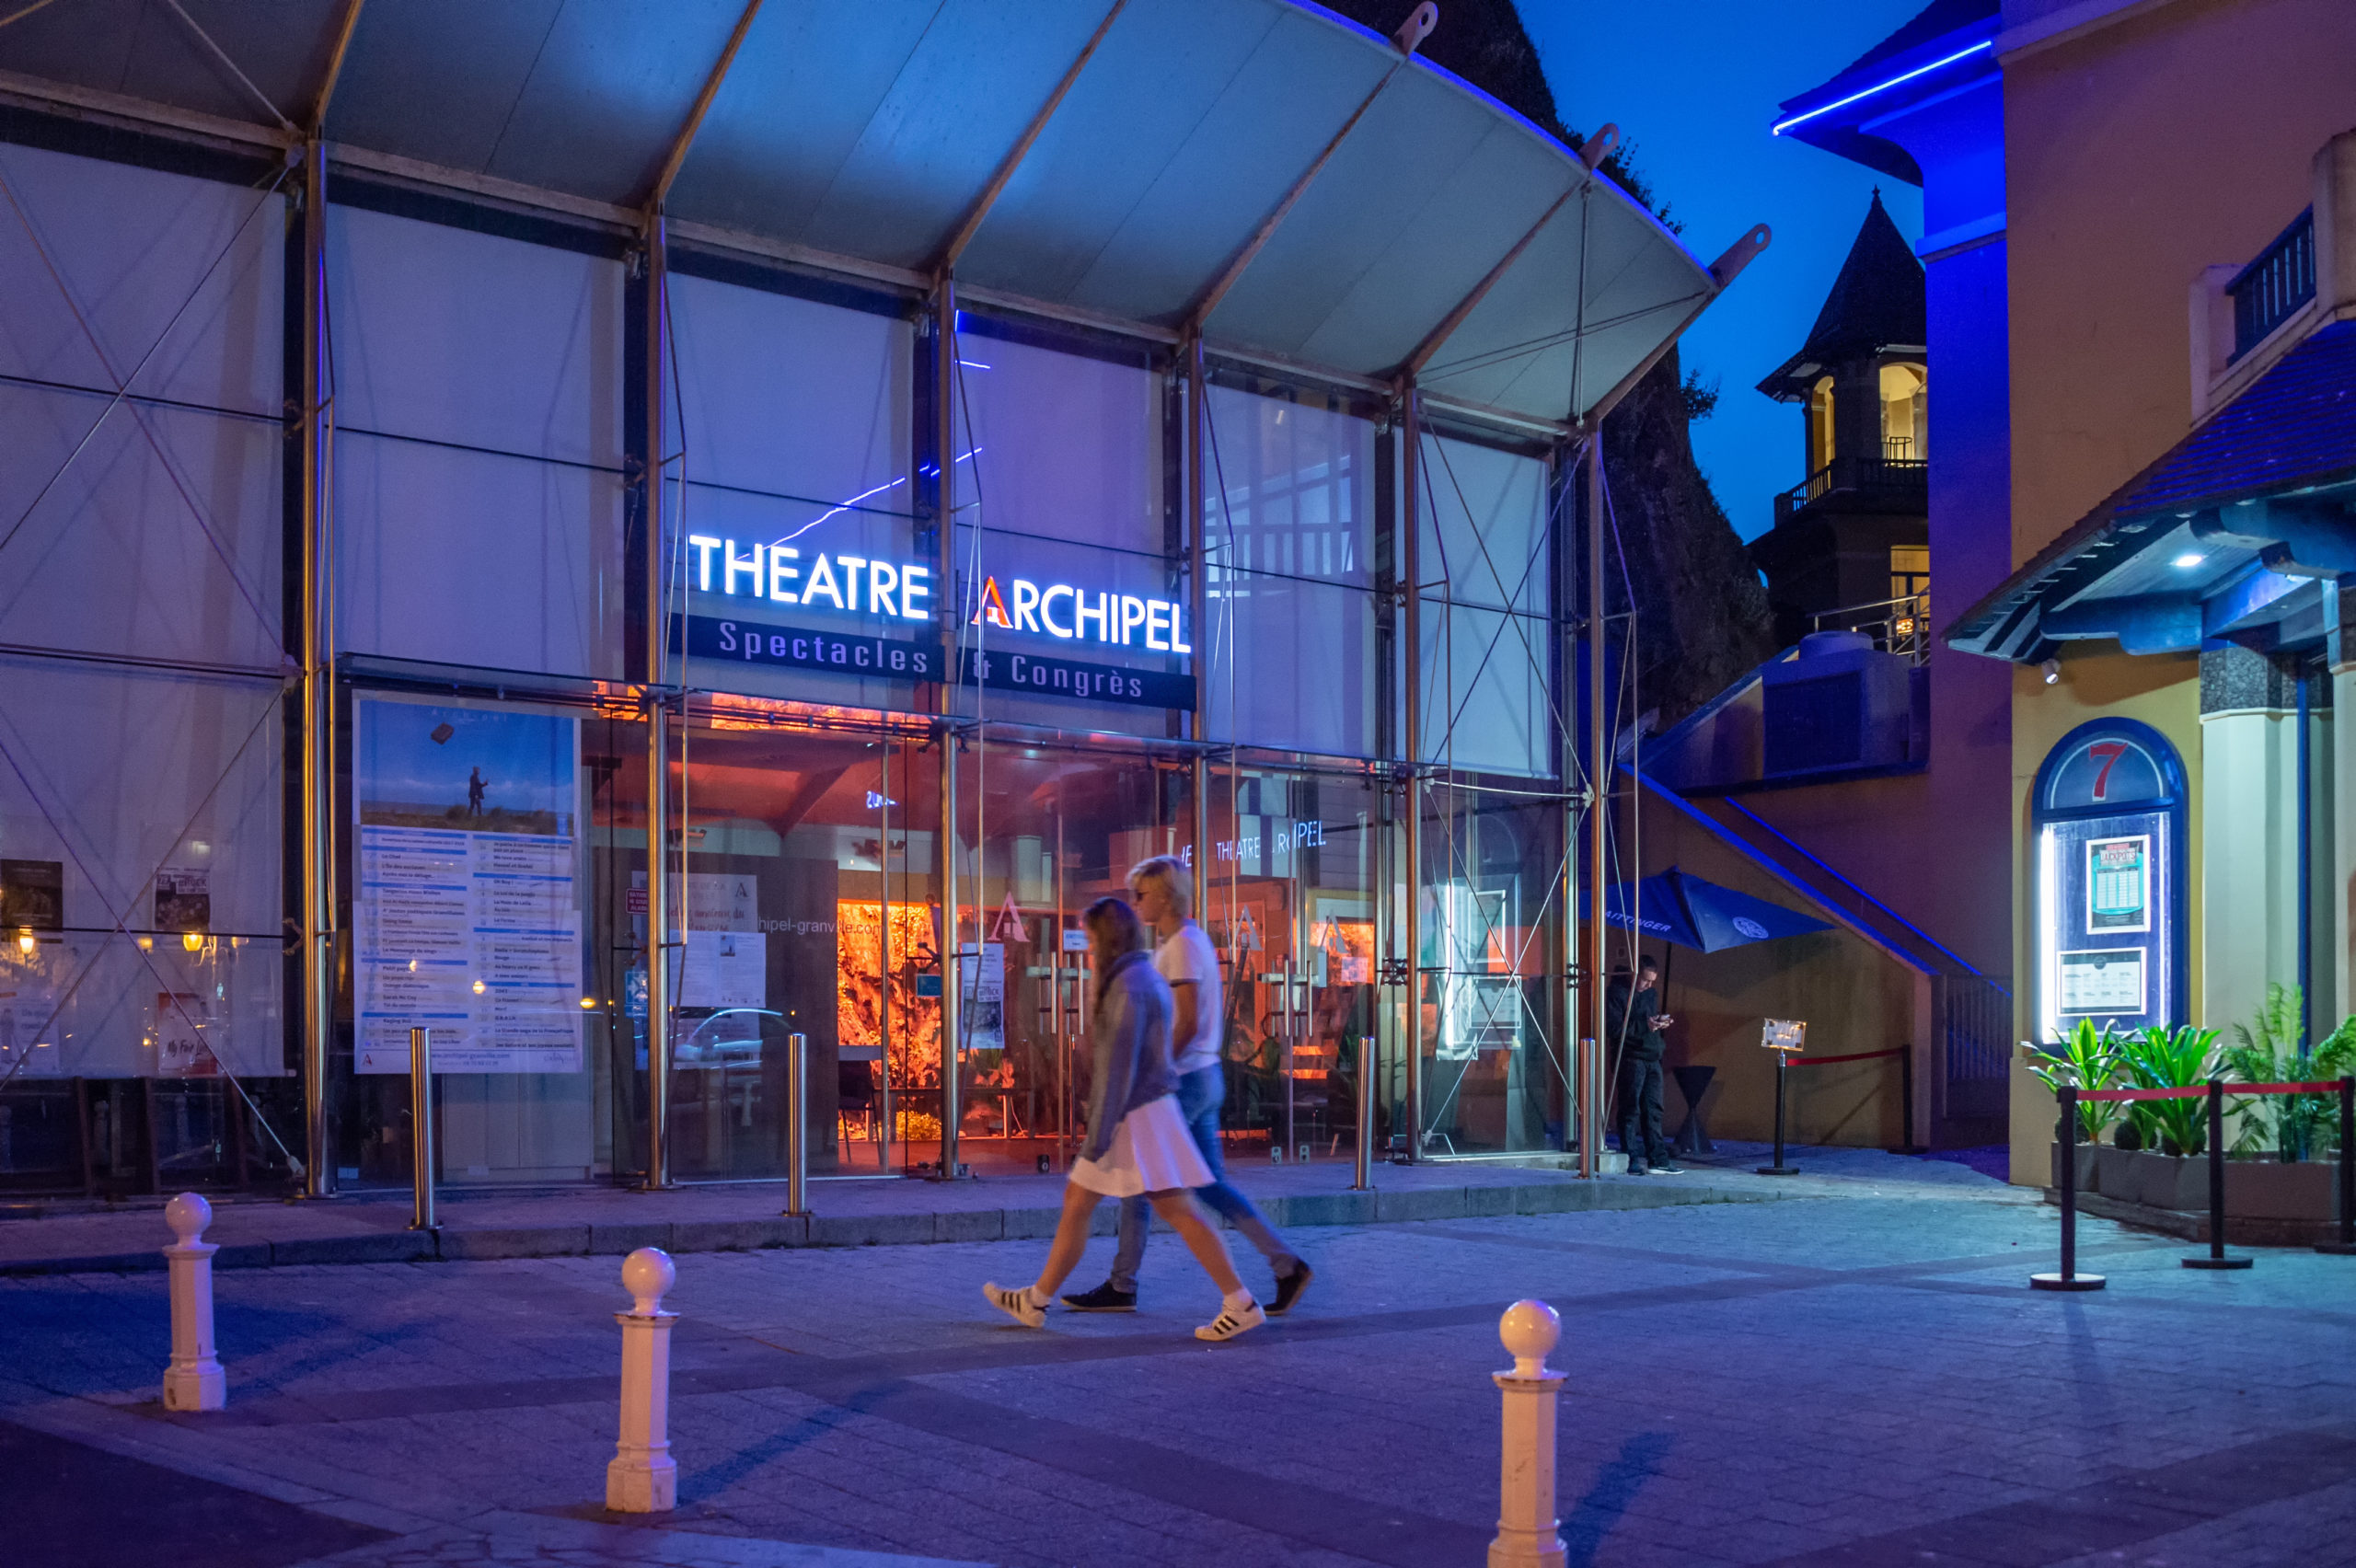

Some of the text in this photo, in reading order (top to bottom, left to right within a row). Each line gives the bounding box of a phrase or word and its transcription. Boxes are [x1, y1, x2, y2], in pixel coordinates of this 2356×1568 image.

[687, 535, 1192, 654] THEATRE ARCHIPEL
[719, 621, 1143, 698] Spectacles & Congrès
[2088, 742, 2129, 802] 7
[1605, 910, 1672, 932] AITTINGER
